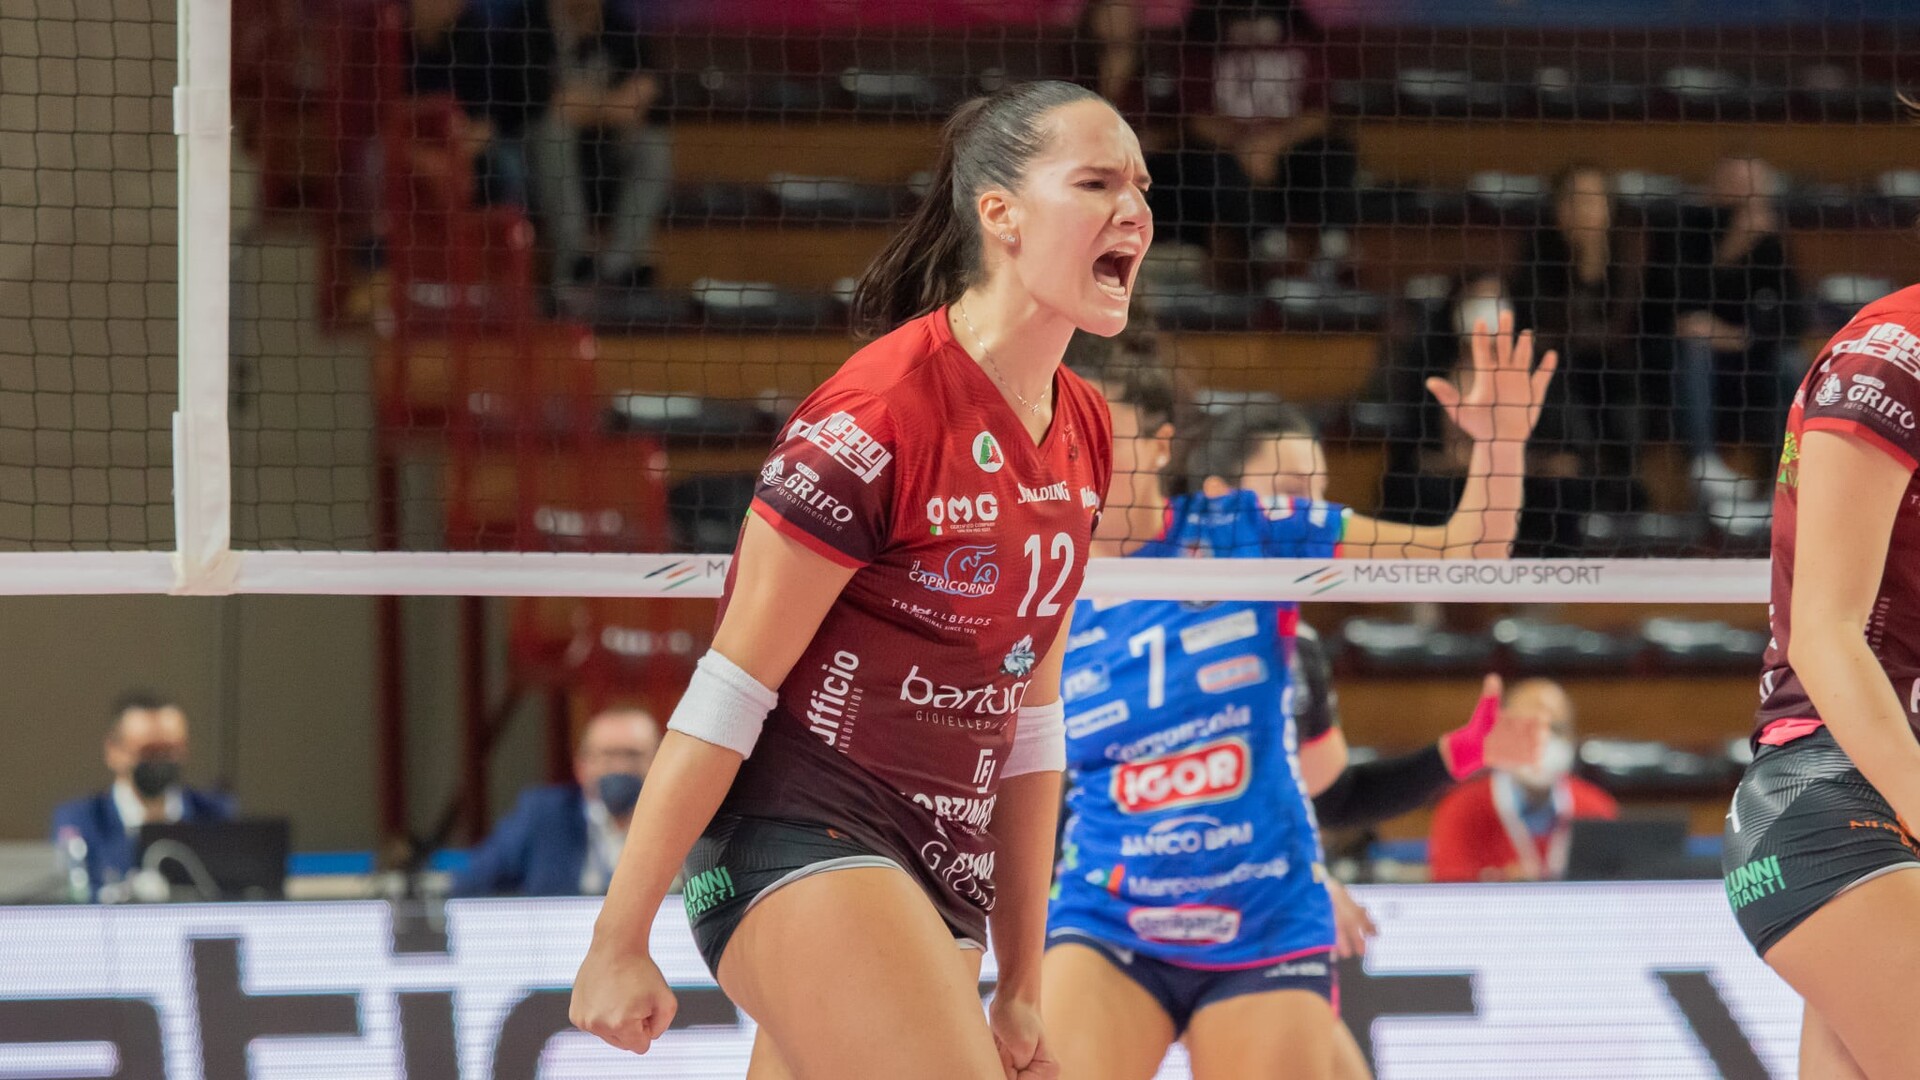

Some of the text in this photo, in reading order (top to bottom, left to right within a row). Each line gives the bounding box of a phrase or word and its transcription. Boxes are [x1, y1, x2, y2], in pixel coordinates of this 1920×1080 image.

[1847, 385, 1916, 429] GRIFO
[784, 473, 853, 523] GRIFO
[926, 493, 999, 525] OMG
[908, 571, 995, 595] CAPRICORNO
[1017, 532, 1075, 617] 12
[1354, 565, 1604, 585] MASTER GROUP SPORT
[891, 598, 992, 626] TRLLBEADS
[1128, 624, 1165, 710] 7
[806, 650, 860, 747] ufficio
[1124, 749, 1238, 806] IGOR
[1121, 822, 1253, 857] BANCO BPM
